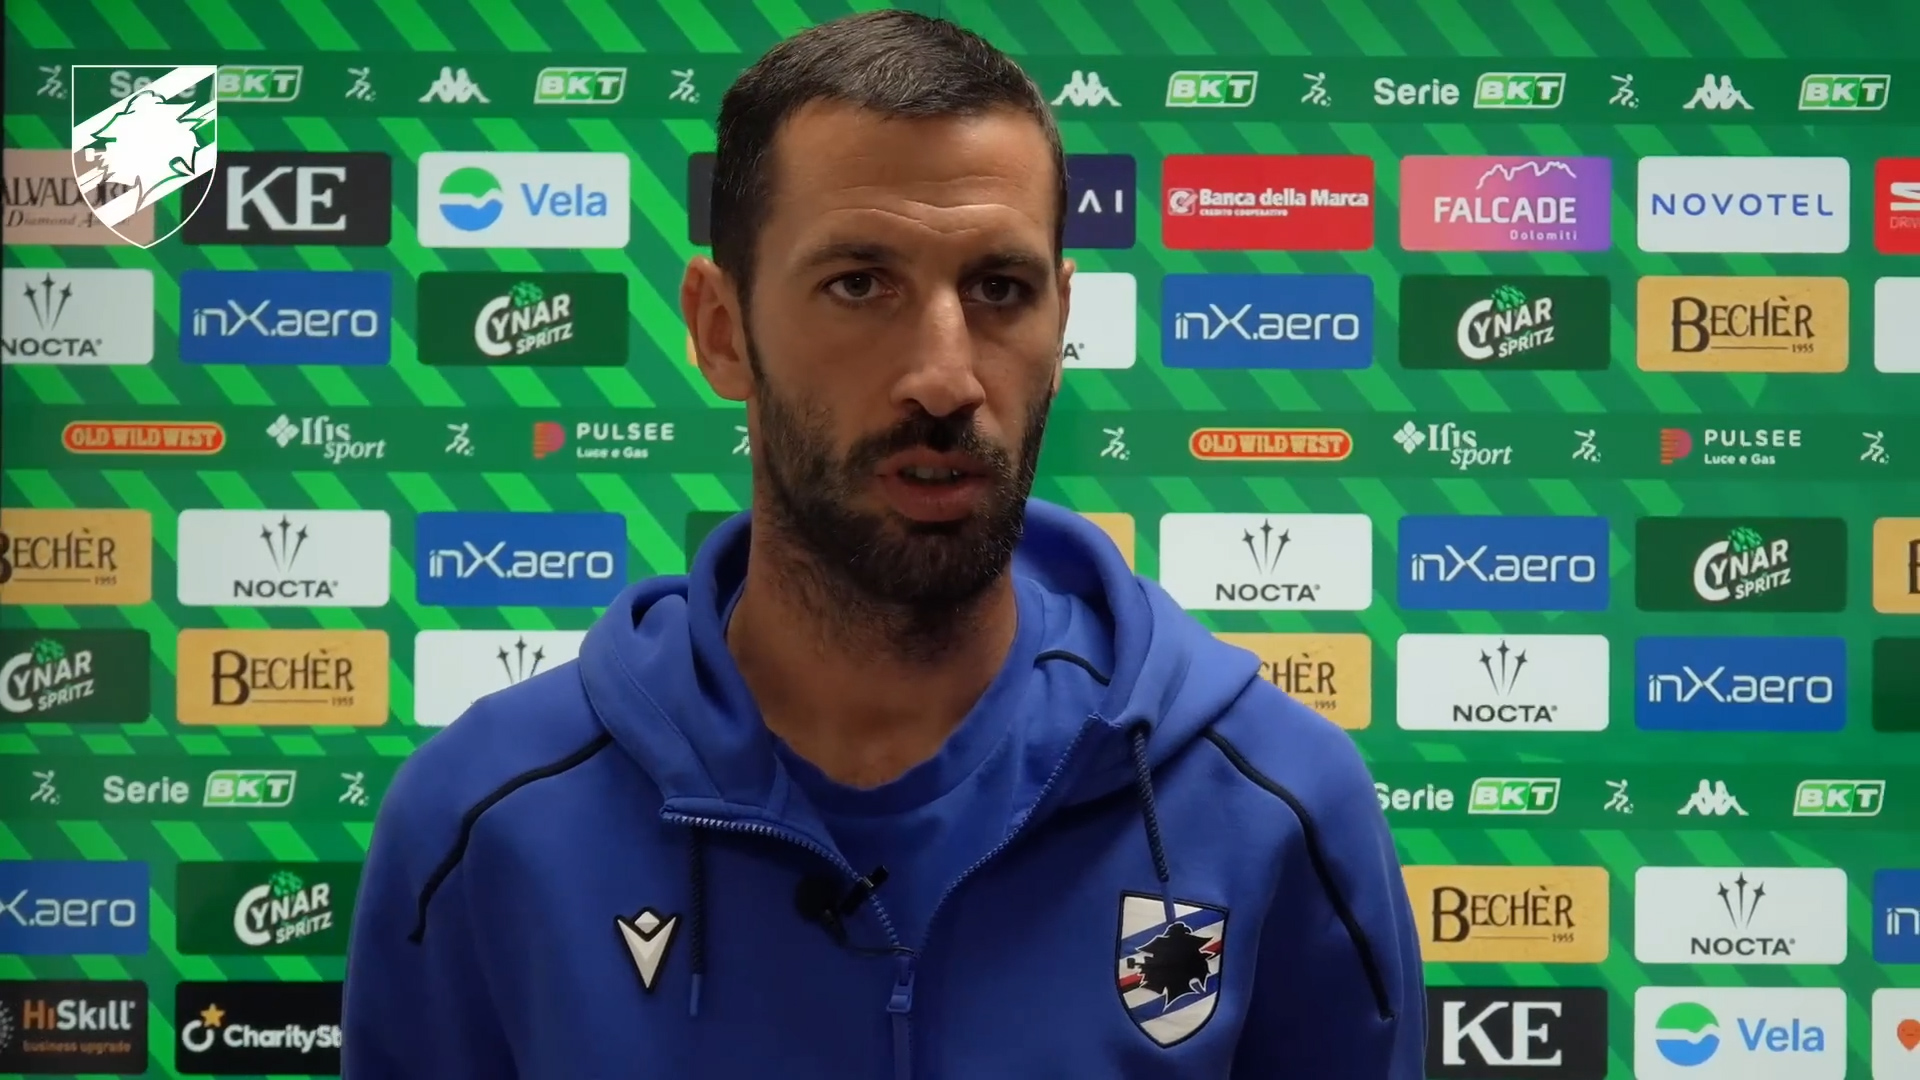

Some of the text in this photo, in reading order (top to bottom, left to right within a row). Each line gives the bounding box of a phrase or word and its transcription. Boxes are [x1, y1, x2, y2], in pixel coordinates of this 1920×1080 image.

[215, 72, 298, 95] BKT
[538, 74, 621, 97] BKT
[1171, 77, 1254, 100] BKT
[1374, 77, 1561, 105] Serie BKT
[1803, 81, 1886, 104] BKT
[226, 166, 346, 230] KE
[520, 183, 608, 216] Vela
[1200, 187, 1369, 207] Banca della Marca
[1434, 196, 1576, 224] FALCADE
[1652, 193, 1834, 216] NOVOTEL
[1509, 229, 1577, 241] Dolomiti
[193, 299, 378, 337] inX.aero
[474, 293, 571, 356] CYNAR
[1175, 303, 1359, 341] inX.aero
[1457, 296, 1553, 360] CYNAR
[1671, 295, 1815, 353] BECHÈR
[515, 321, 573, 355] SPRITZ
[1498, 325, 1555, 358] SPRITZ
[1792, 343, 1814, 353] 1955
[71, 427, 217, 447] OLD WILD WEST
[576, 422, 675, 441] PULSEE
[1199, 434, 1343, 454] OLD WILD WEST
[1704, 429, 1802, 447] PULSEE
[323, 438, 386, 464] sport
[576, 446, 649, 459] Luce e Gas
[1450, 445, 1513, 470] sport
[1704, 453, 1776, 465] Luce e Gas
[429, 540, 614, 579] inX.aero
[1411, 544, 1596, 583] inX.aero
[1693, 538, 1789, 601] CYNAR
[233, 580, 334, 598] NOCTA
[1215, 583, 1316, 602] NOCTA
[1734, 567, 1792, 600] SPRITZ
[0, 650, 92, 713] CYNAR
[212, 648, 355, 706] BECHÈR
[1648, 666, 1833, 703] inX.aero
[38, 678, 95, 712] SPRITZ
[1453, 704, 1553, 723] NOCTA
[103, 775, 291, 804] Serie BKT
[1374, 782, 1555, 811] Serie BKT
[1798, 786, 1881, 810] BKT
[234, 882, 330, 945] CYNAR
[275, 911, 332, 944] SPRITZ
[1431, 885, 1575, 943] BECHÈR
[1552, 933, 1574, 943] 1955
[1690, 937, 1790, 956] NOCTA
[23, 999, 132, 1030] HiSkill
[23, 1040, 131, 1055] business upgrade
[1443, 1001, 1562, 1066] KE
[1737, 1018, 1825, 1052] Vela
